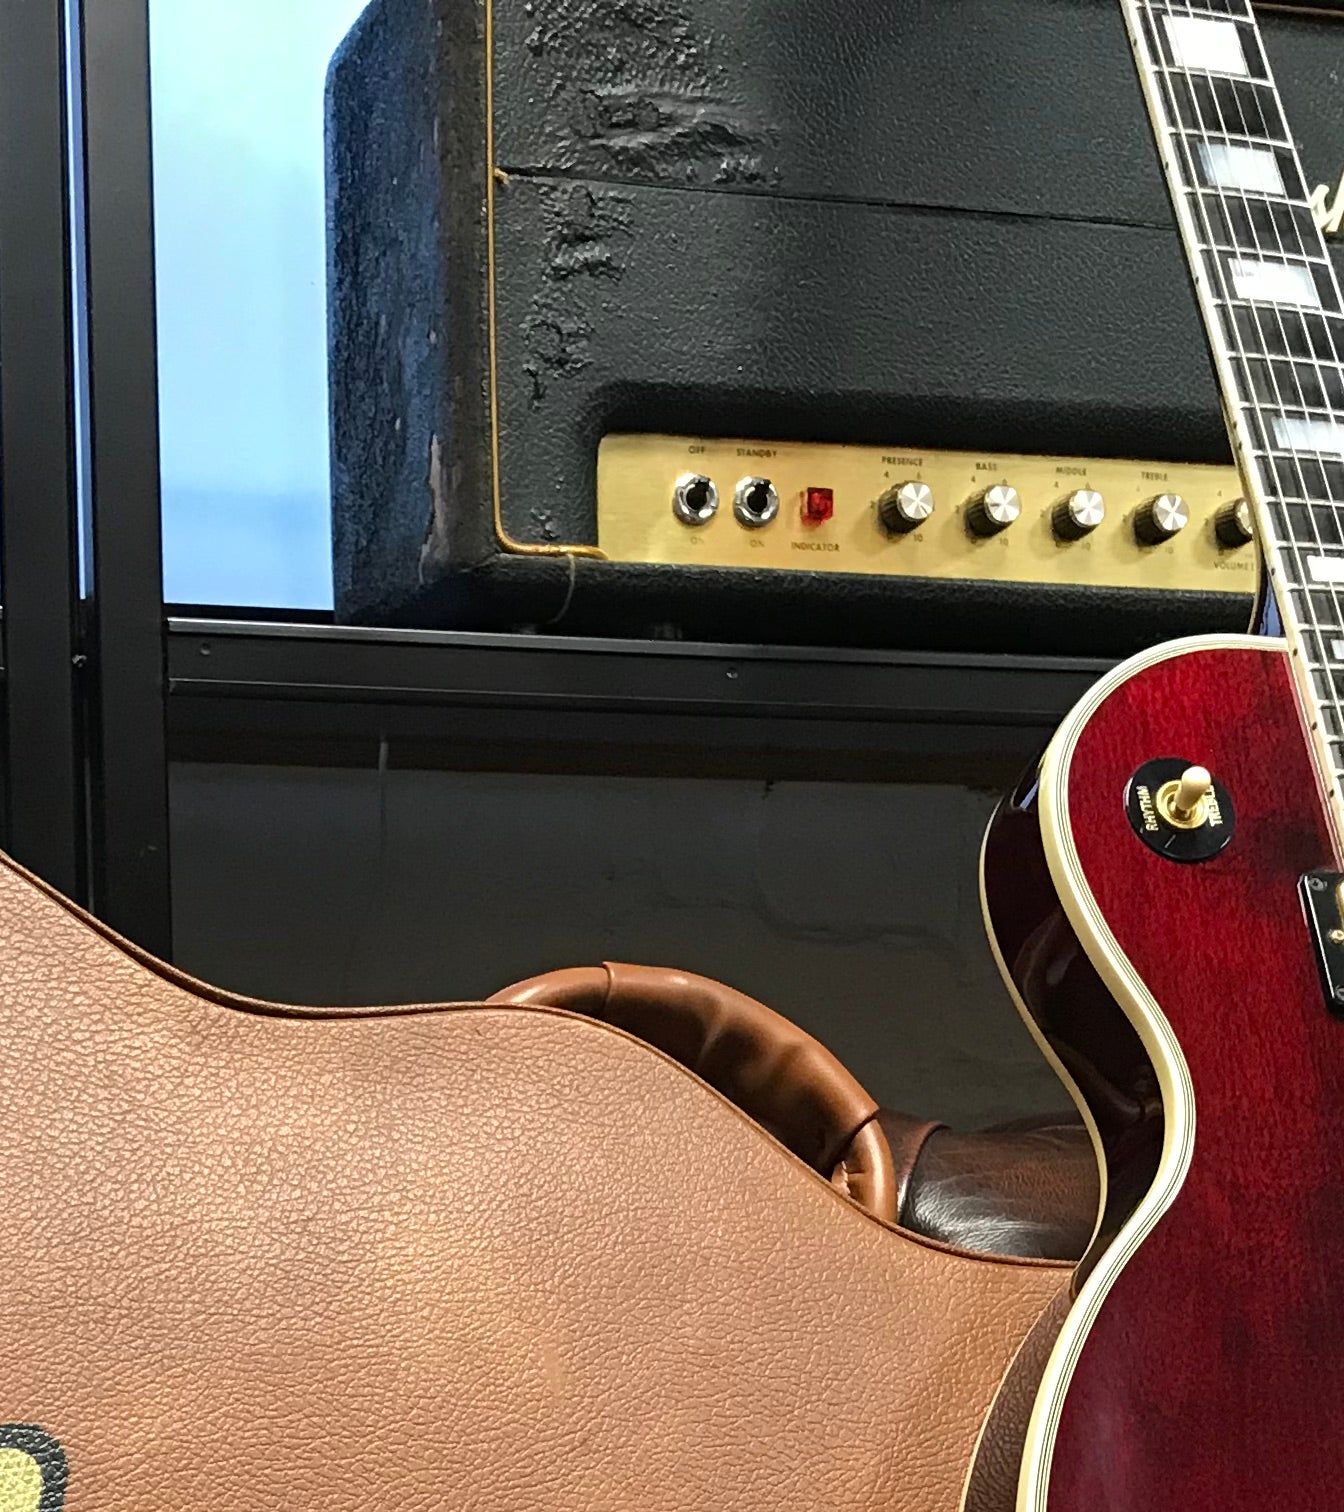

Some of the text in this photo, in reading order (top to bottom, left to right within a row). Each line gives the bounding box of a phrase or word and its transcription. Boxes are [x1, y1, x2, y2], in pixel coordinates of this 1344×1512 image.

[736, 448, 777, 458] STANDBY
[881, 456, 923, 467] PRESENCE
[976, 462, 998, 471] BASS
[791, 541, 840, 552] INDICATOR
[1136, 785, 1159, 831] RHYTHM
